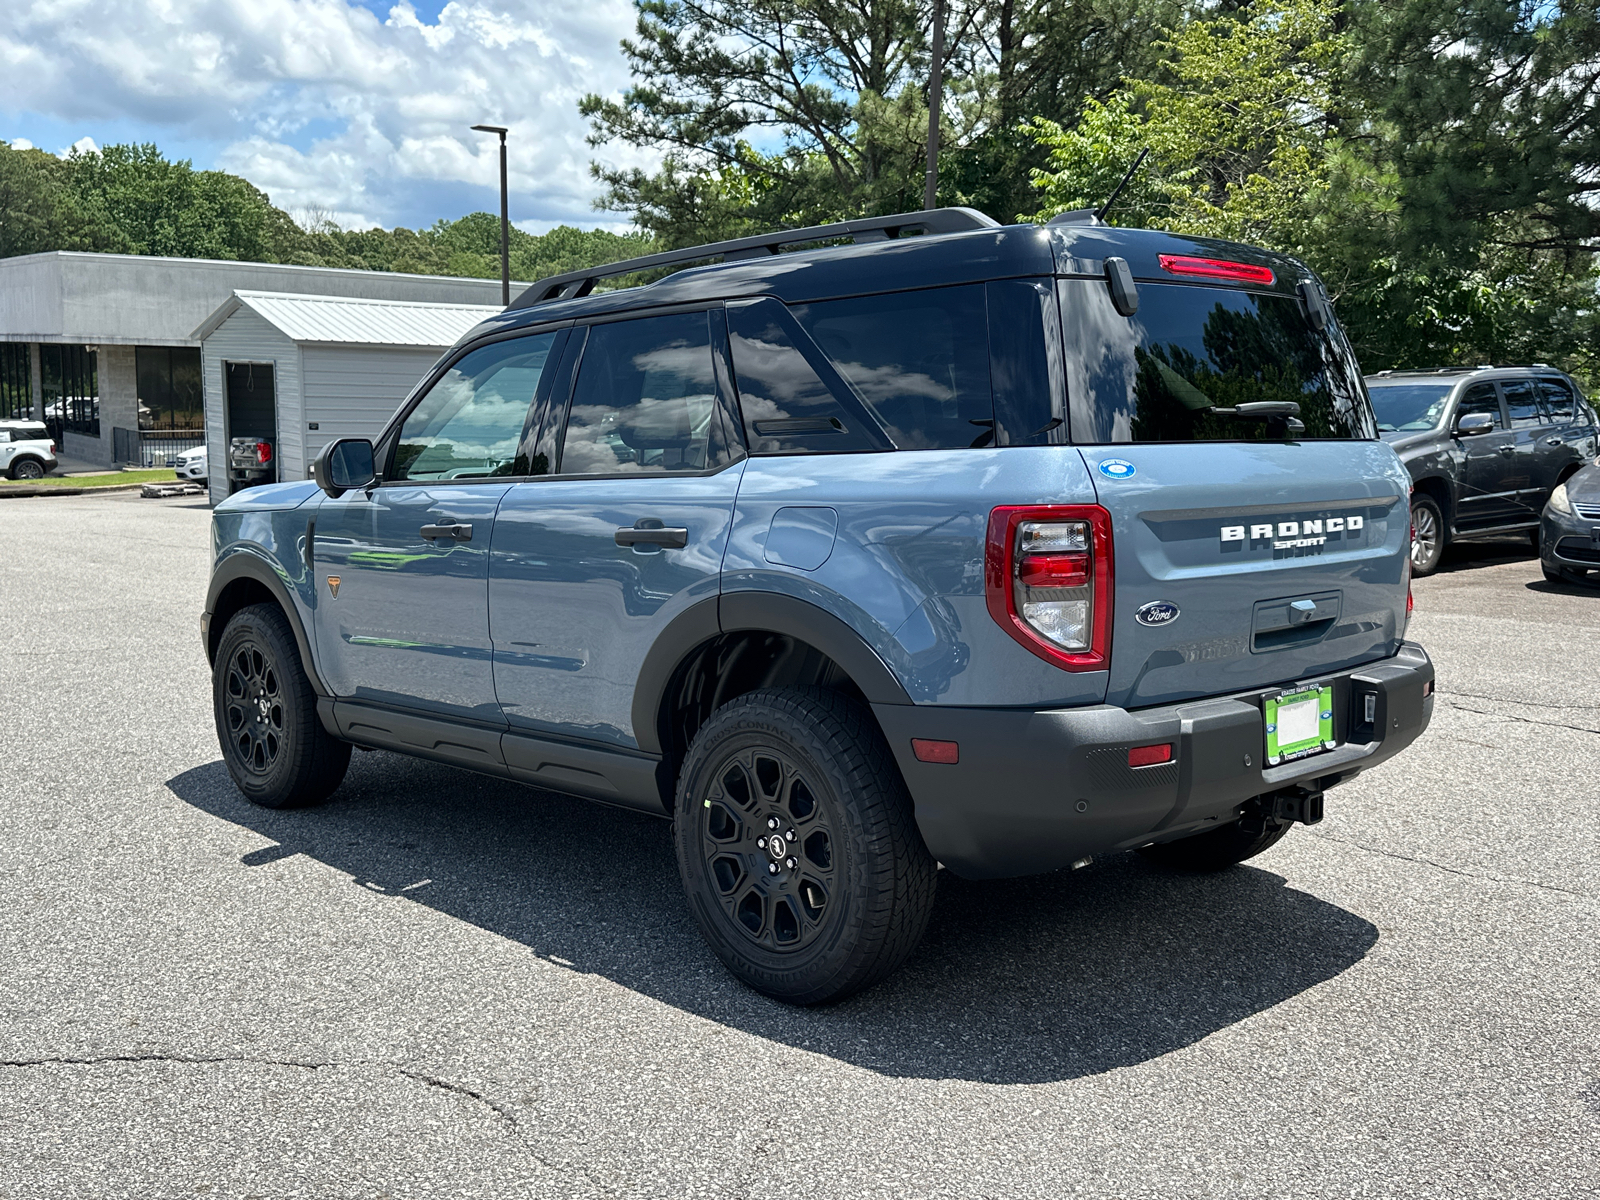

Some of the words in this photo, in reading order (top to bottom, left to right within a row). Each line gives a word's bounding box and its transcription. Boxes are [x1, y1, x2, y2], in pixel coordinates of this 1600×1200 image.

[1221, 516, 1363, 541] BRONCO
[1273, 537, 1327, 549] SPORT
[1147, 606, 1172, 621] Ford
